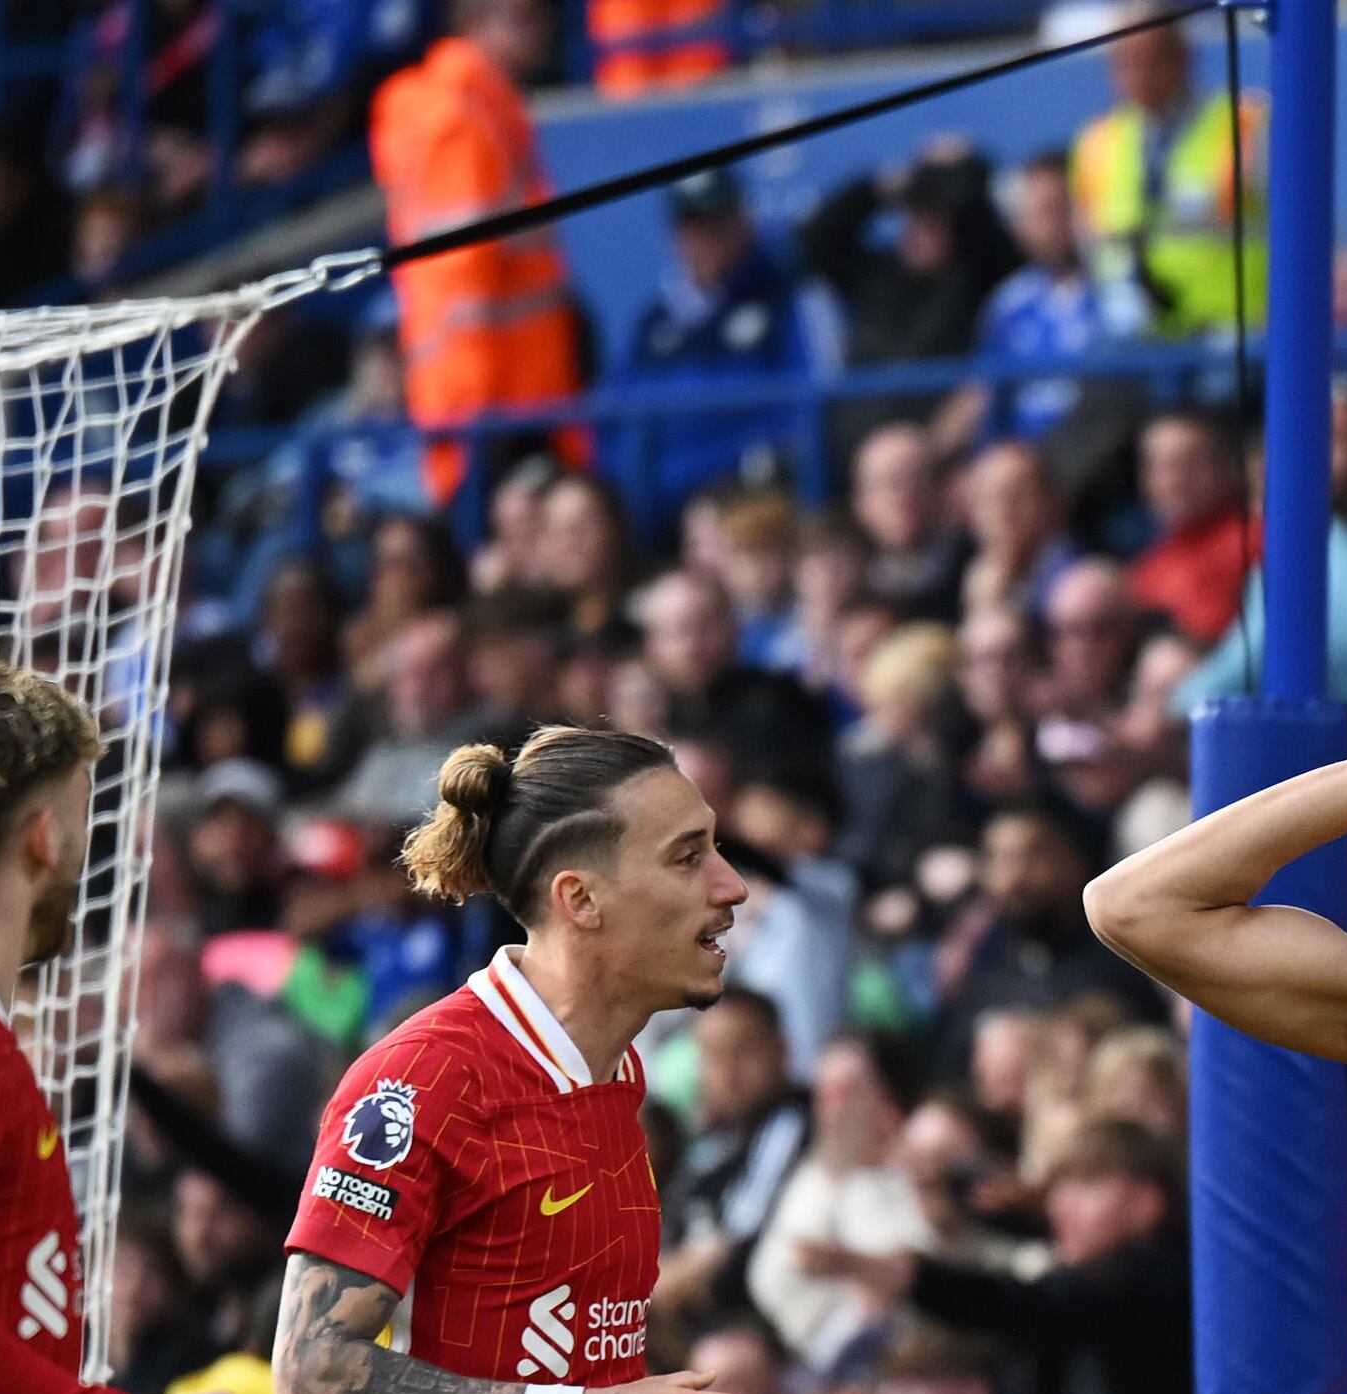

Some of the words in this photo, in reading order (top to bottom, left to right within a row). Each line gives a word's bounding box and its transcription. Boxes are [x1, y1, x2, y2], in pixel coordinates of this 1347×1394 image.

[315, 1165, 342, 1185] No
[341, 1175, 390, 1204] room
[336, 1188, 393, 1221] racism
